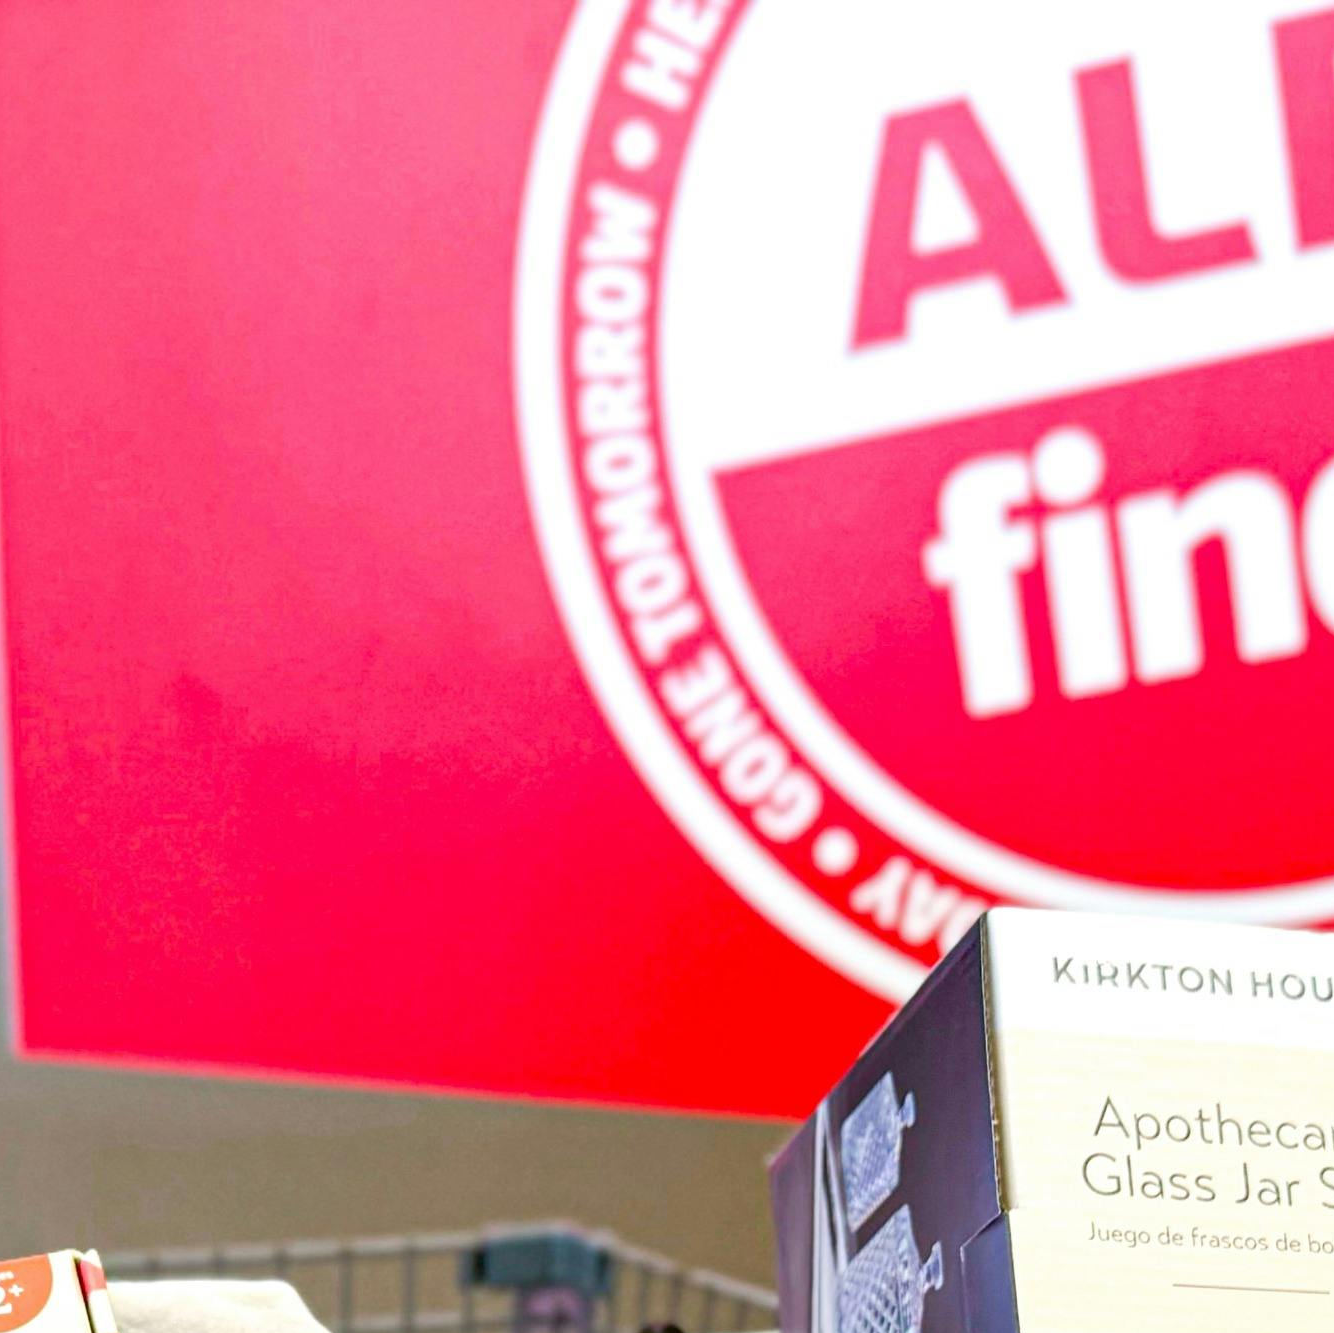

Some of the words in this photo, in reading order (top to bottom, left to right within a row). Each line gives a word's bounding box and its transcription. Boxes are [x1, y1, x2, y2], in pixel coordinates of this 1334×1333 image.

[574, 182, 703, 668] TOMORROW
[662, 643, 827, 845] GONE
[1052, 955, 1233, 997] KIRKTON
[1081, 1151, 1217, 1203] Glass
[1234, 1161, 1301, 1208] Jar
[1087, 1221, 1152, 1248] Juego
[1157, 1225, 1185, 1246] de
[1190, 1225, 1270, 1252] frascos
[1274, 1233, 1302, 1253] de
